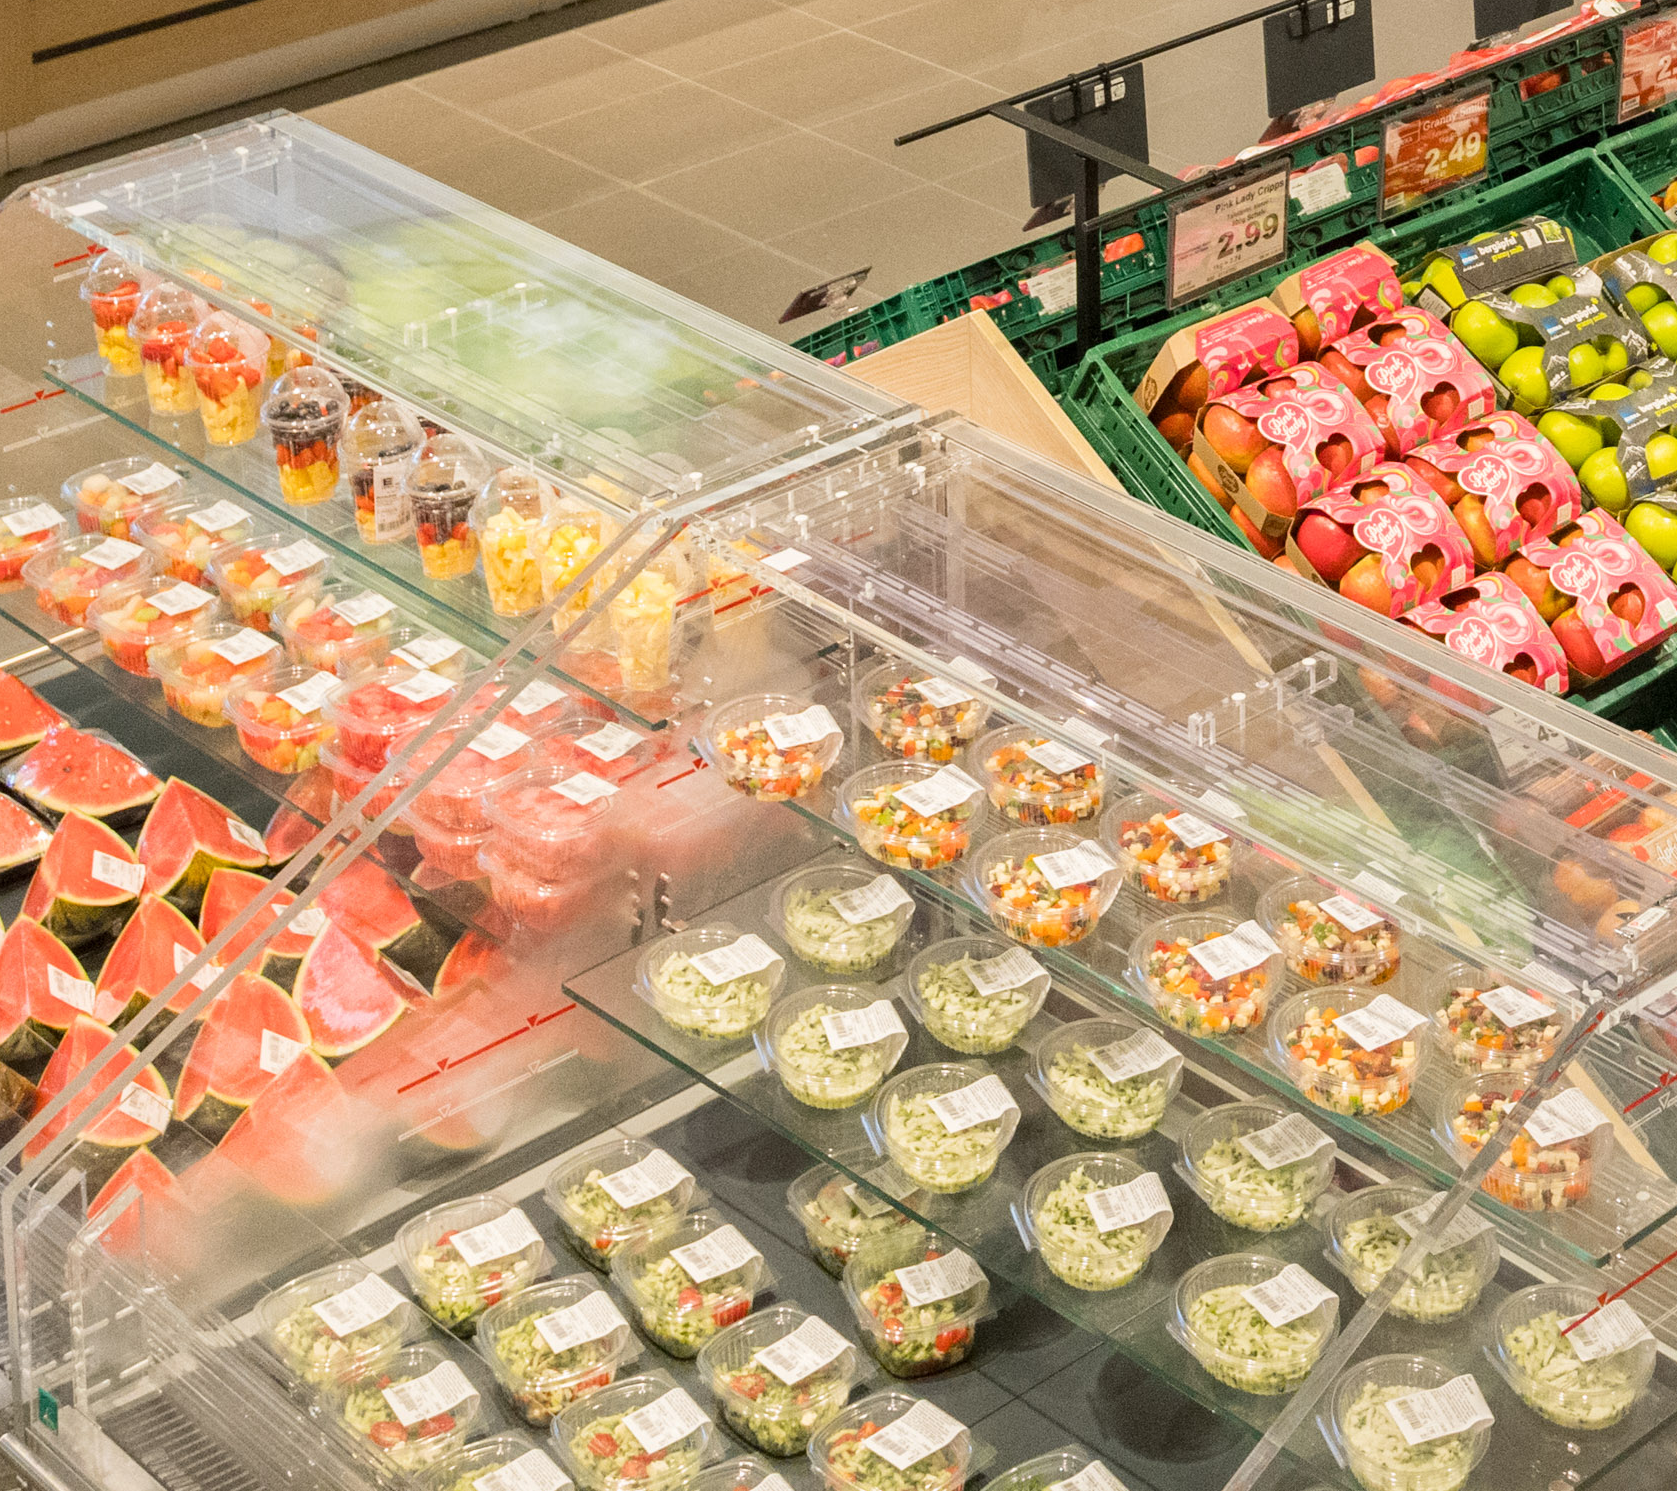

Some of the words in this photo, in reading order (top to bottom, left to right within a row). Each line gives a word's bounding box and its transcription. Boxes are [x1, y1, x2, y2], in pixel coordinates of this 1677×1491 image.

[1425, 131, 1482, 176] 2.49
[1218, 212, 1279, 260] 2.99
[1378, 356, 1404, 379] Pink
[1388, 368, 1415, 392] Lady
[1270, 407, 1296, 430] Pink
[1281, 418, 1307, 441] Lady
[1471, 460, 1495, 483] Pink
[1482, 471, 1508, 495] Lady
[1367, 514, 1390, 536] Pink
[1375, 525, 1403, 549] Lady
[1563, 555, 1587, 577] Pink
[1572, 565, 1599, 590] Lady
[1459, 624, 1483, 648] Pink
[1470, 634, 1496, 658] Lady
